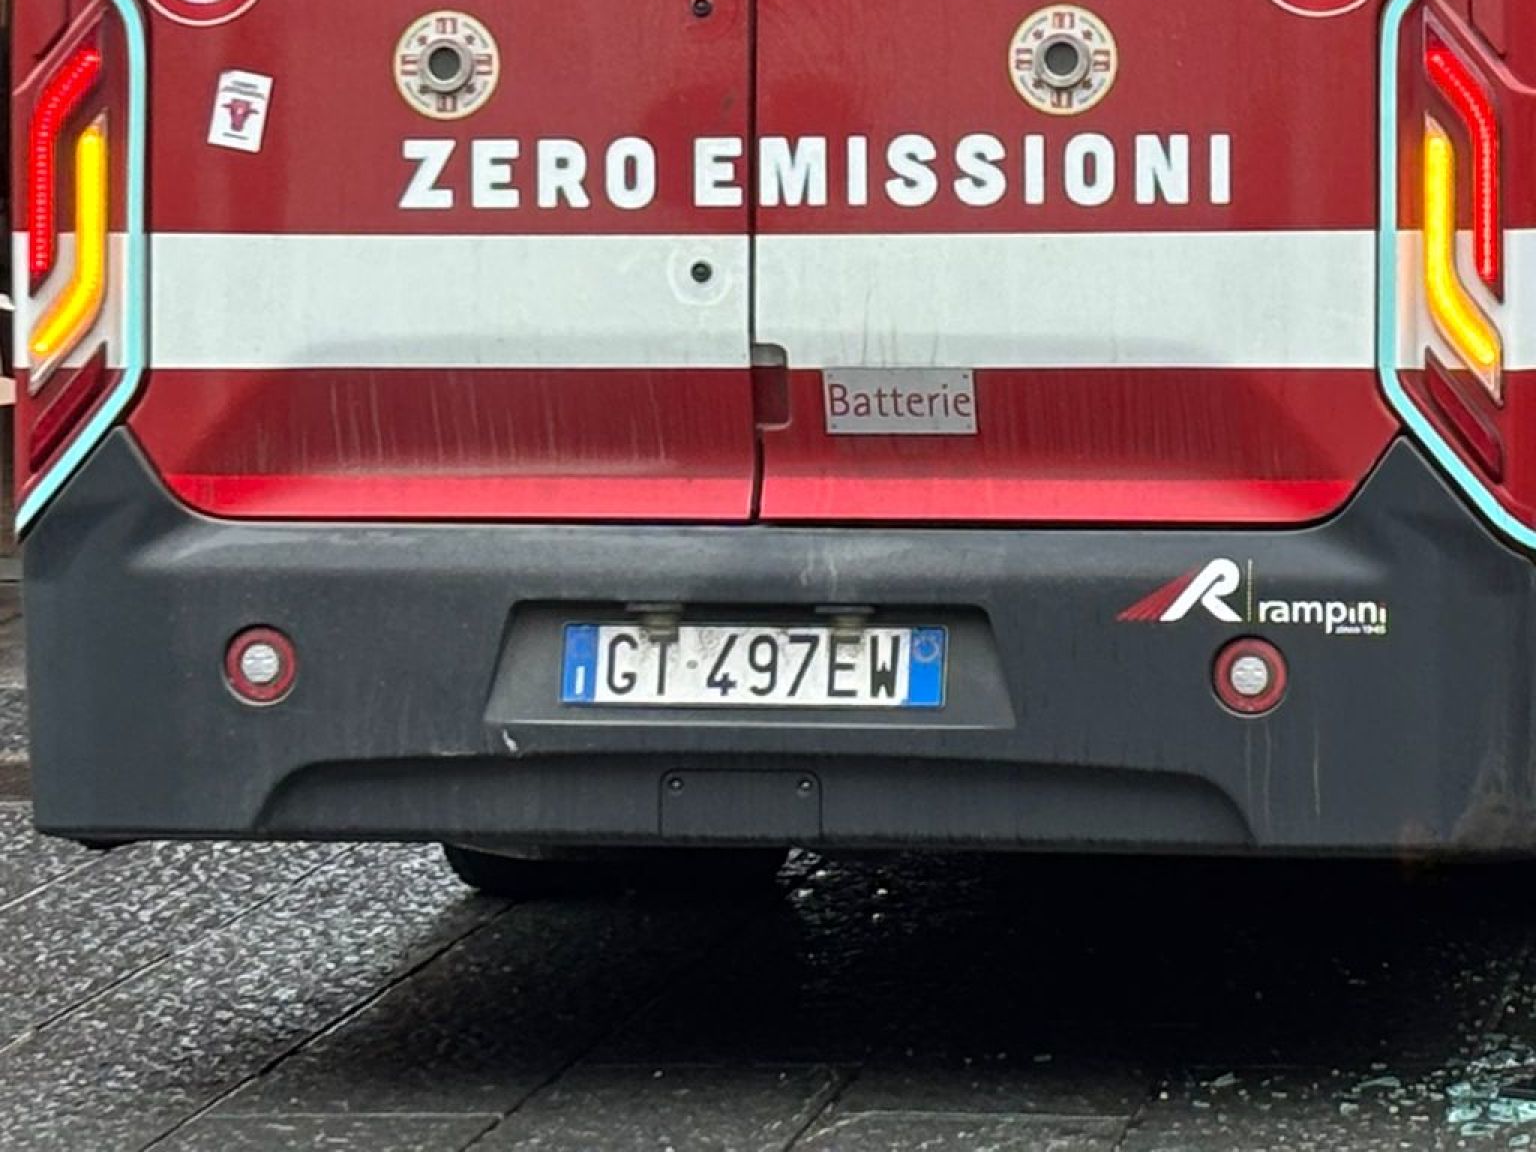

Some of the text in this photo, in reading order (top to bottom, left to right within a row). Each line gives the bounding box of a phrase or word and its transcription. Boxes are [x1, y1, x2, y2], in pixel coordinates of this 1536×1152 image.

[399, 133, 1232, 210] ZERO EMISSIONI
[828, 383, 972, 418] Batterie
[1258, 599, 1388, 634] rampini
